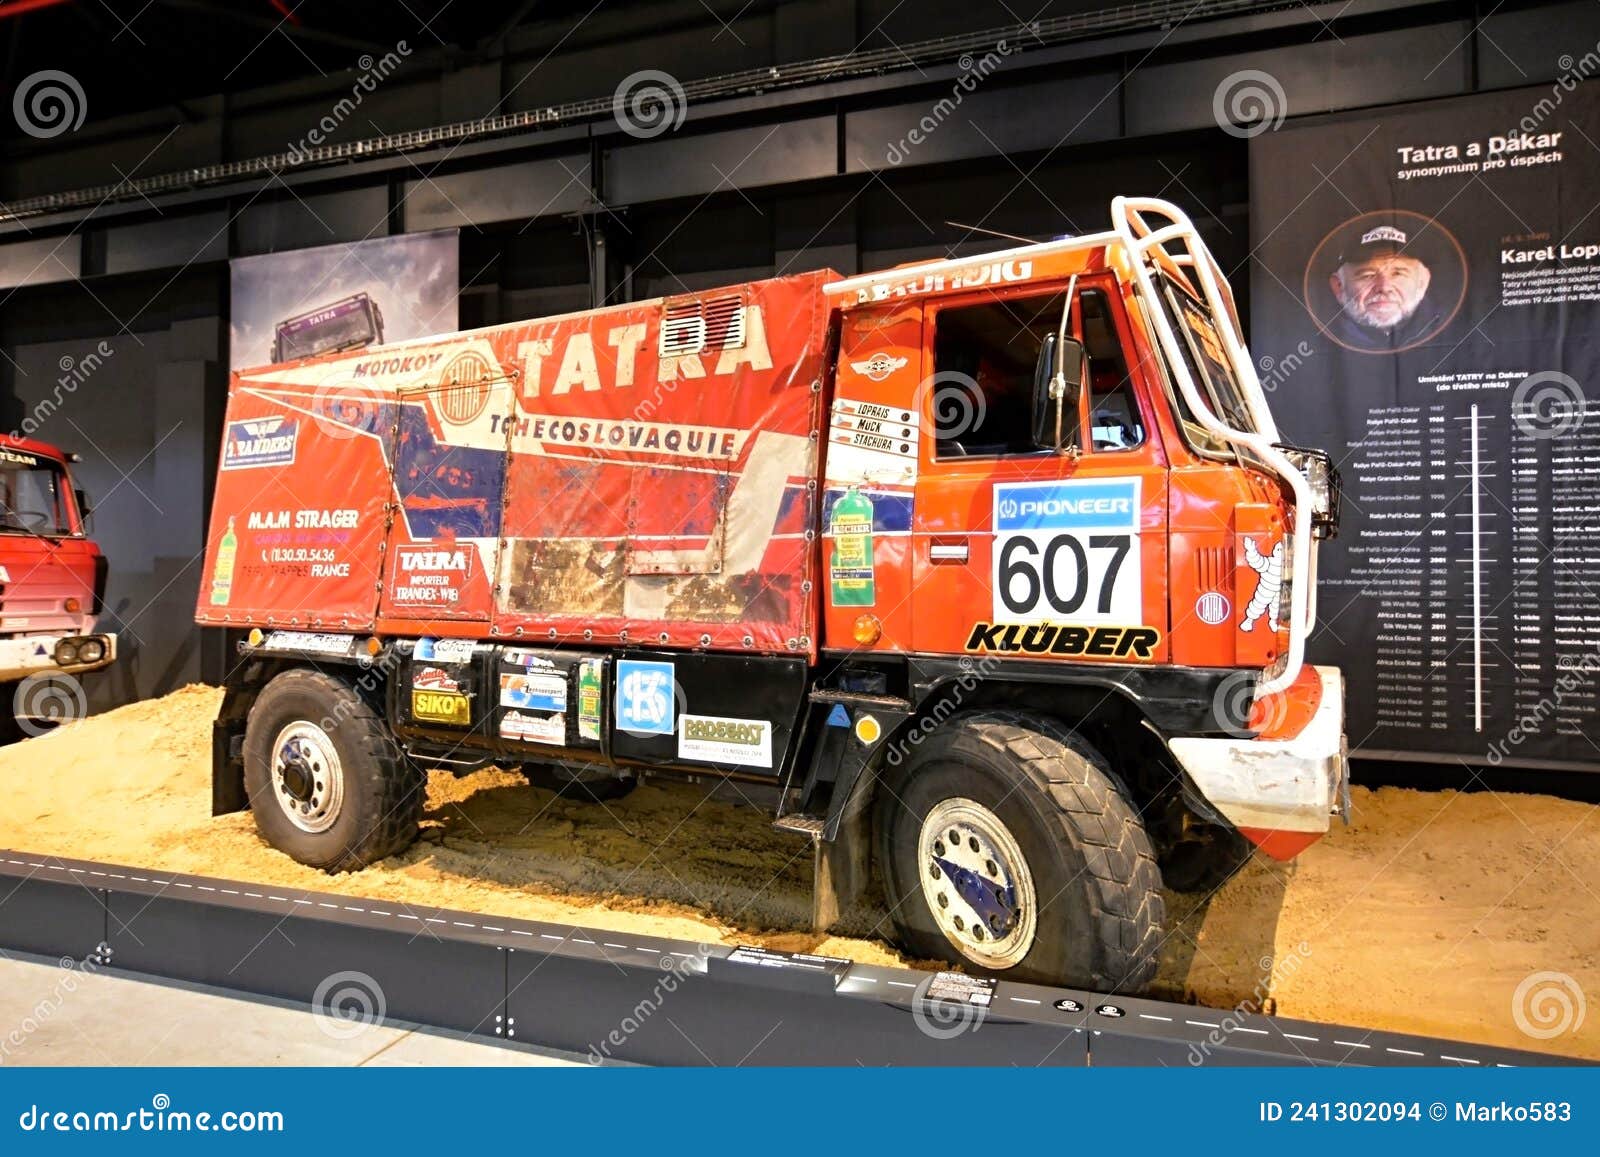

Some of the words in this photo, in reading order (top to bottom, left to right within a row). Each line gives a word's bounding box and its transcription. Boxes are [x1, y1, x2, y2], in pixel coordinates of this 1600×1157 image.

[1397, 145, 1458, 164] Tatra
[1466, 142, 1481, 157] a
[1488, 131, 1562, 154] Dakar
[1397, 163, 1478, 180] synonymum
[1482, 159, 1506, 171] pro
[1510, 151, 1562, 168] úspěch
[1501, 246, 1556, 264] Karel
[1560, 243, 1600, 260] Lop
[309, 310, 336, 326] TATRA
[517, 305, 773, 398] TATRA
[491, 415, 736, 456] TCHECOSLOVAQUIE
[853, 434, 892, 451] STACHURA
[1020, 498, 1130, 516] PIONEER
[295, 509, 358, 529] STRAGER
[311, 564, 350, 577] FRANCE
[400, 552, 465, 571] TATRA
[998, 534, 1131, 615] 607
[966, 624, 1158, 661] KLÜBER
[685, 719, 765, 745] RADEGAST
